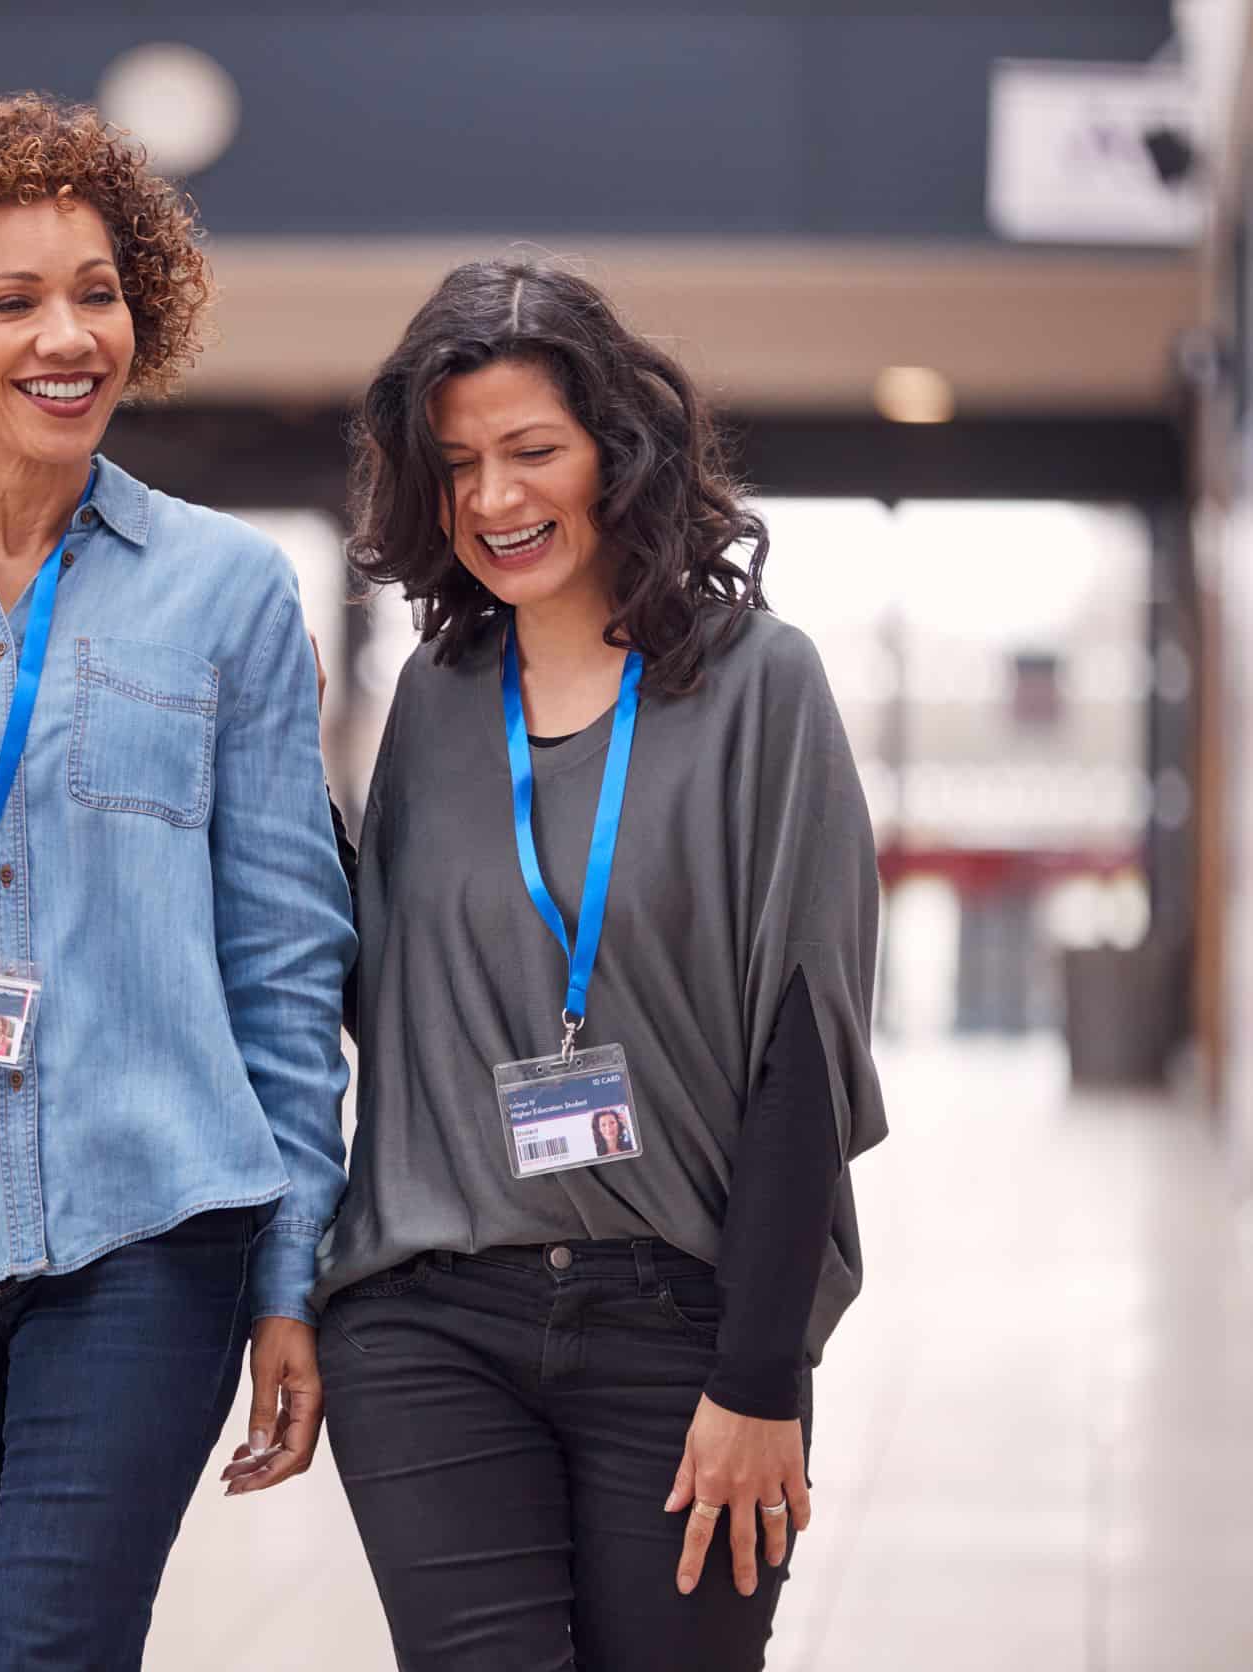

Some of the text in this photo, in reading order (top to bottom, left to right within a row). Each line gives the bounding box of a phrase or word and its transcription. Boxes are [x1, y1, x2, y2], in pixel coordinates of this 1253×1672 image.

[592, 1074, 620, 1086] ID CARD
[511, 1099, 588, 1120] Higher Education Student
